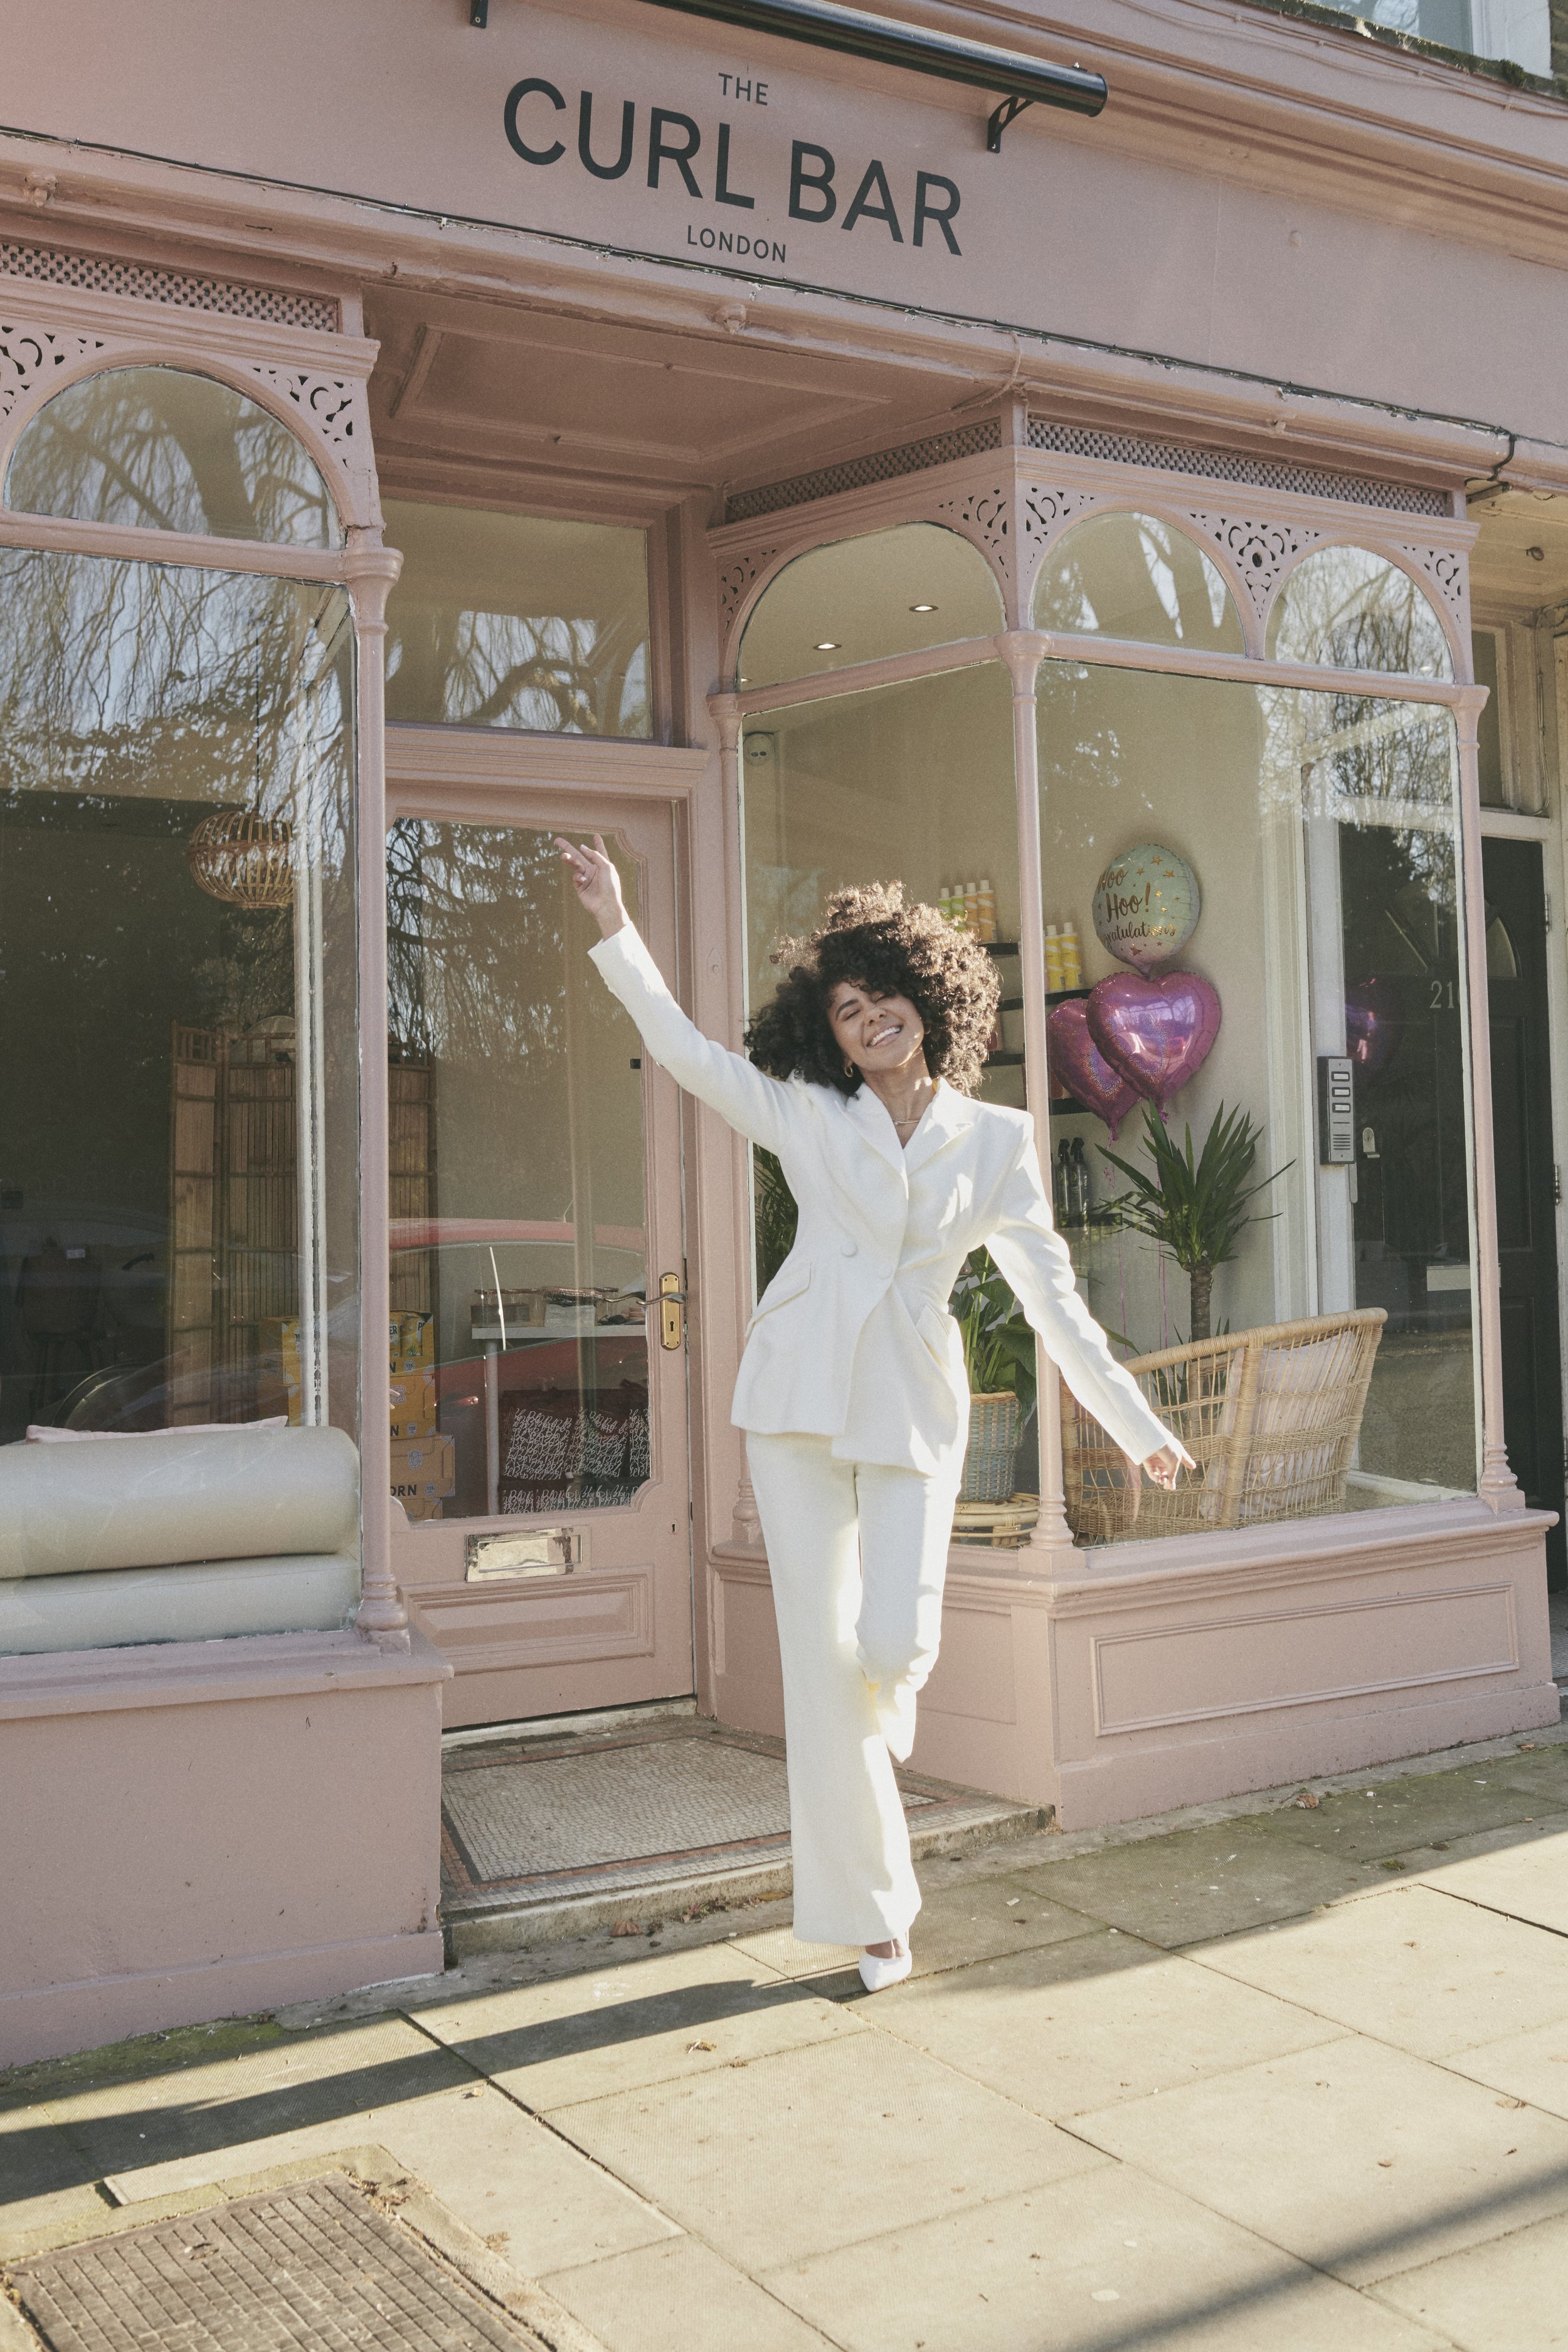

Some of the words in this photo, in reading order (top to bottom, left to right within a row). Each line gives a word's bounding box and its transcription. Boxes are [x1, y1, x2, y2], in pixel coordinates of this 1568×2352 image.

[718, 72, 769, 106] THE
[504, 77, 755, 209] CURL
[788, 139, 962, 257] BAR
[687, 225, 787, 263] LONDON
[1106, 882, 1151, 923] Hoo!
[1103, 921, 1176, 950] gratulations
[1430, 980, 1460, 1009] 21
[389, 1485, 417, 1496] ORN
